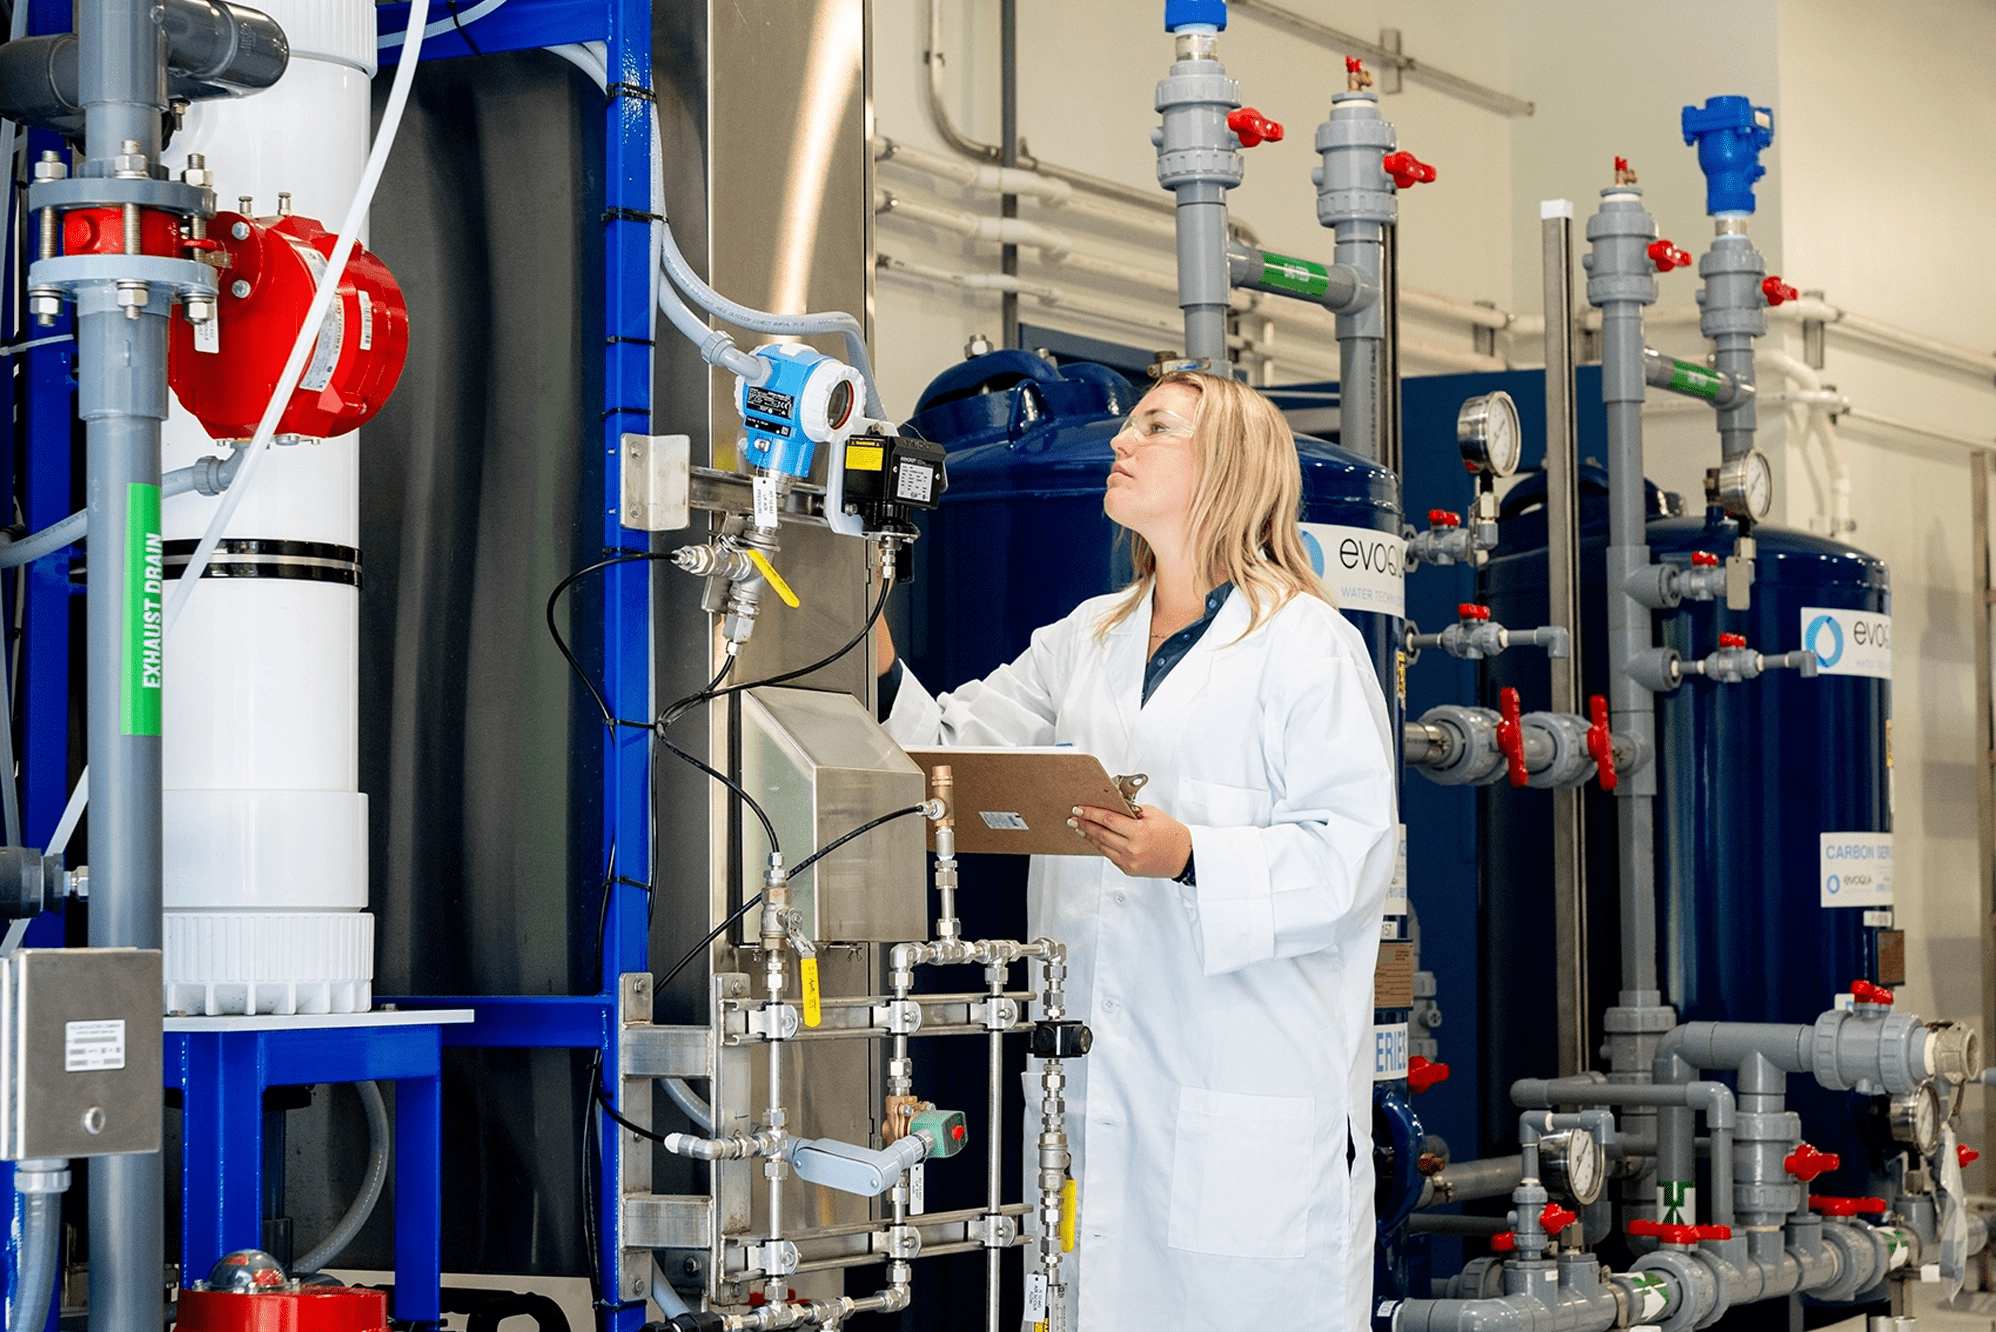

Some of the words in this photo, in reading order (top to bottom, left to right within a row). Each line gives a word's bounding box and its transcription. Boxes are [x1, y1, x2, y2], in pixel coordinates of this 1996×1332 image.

[145, 532, 162, 595] DRAIN
[1341, 587, 1374, 601] WATER
[143, 597, 161, 689] EXHAUST
[1825, 844, 1875, 861] CARBON
[1375, 1029, 1406, 1073] ERIES
